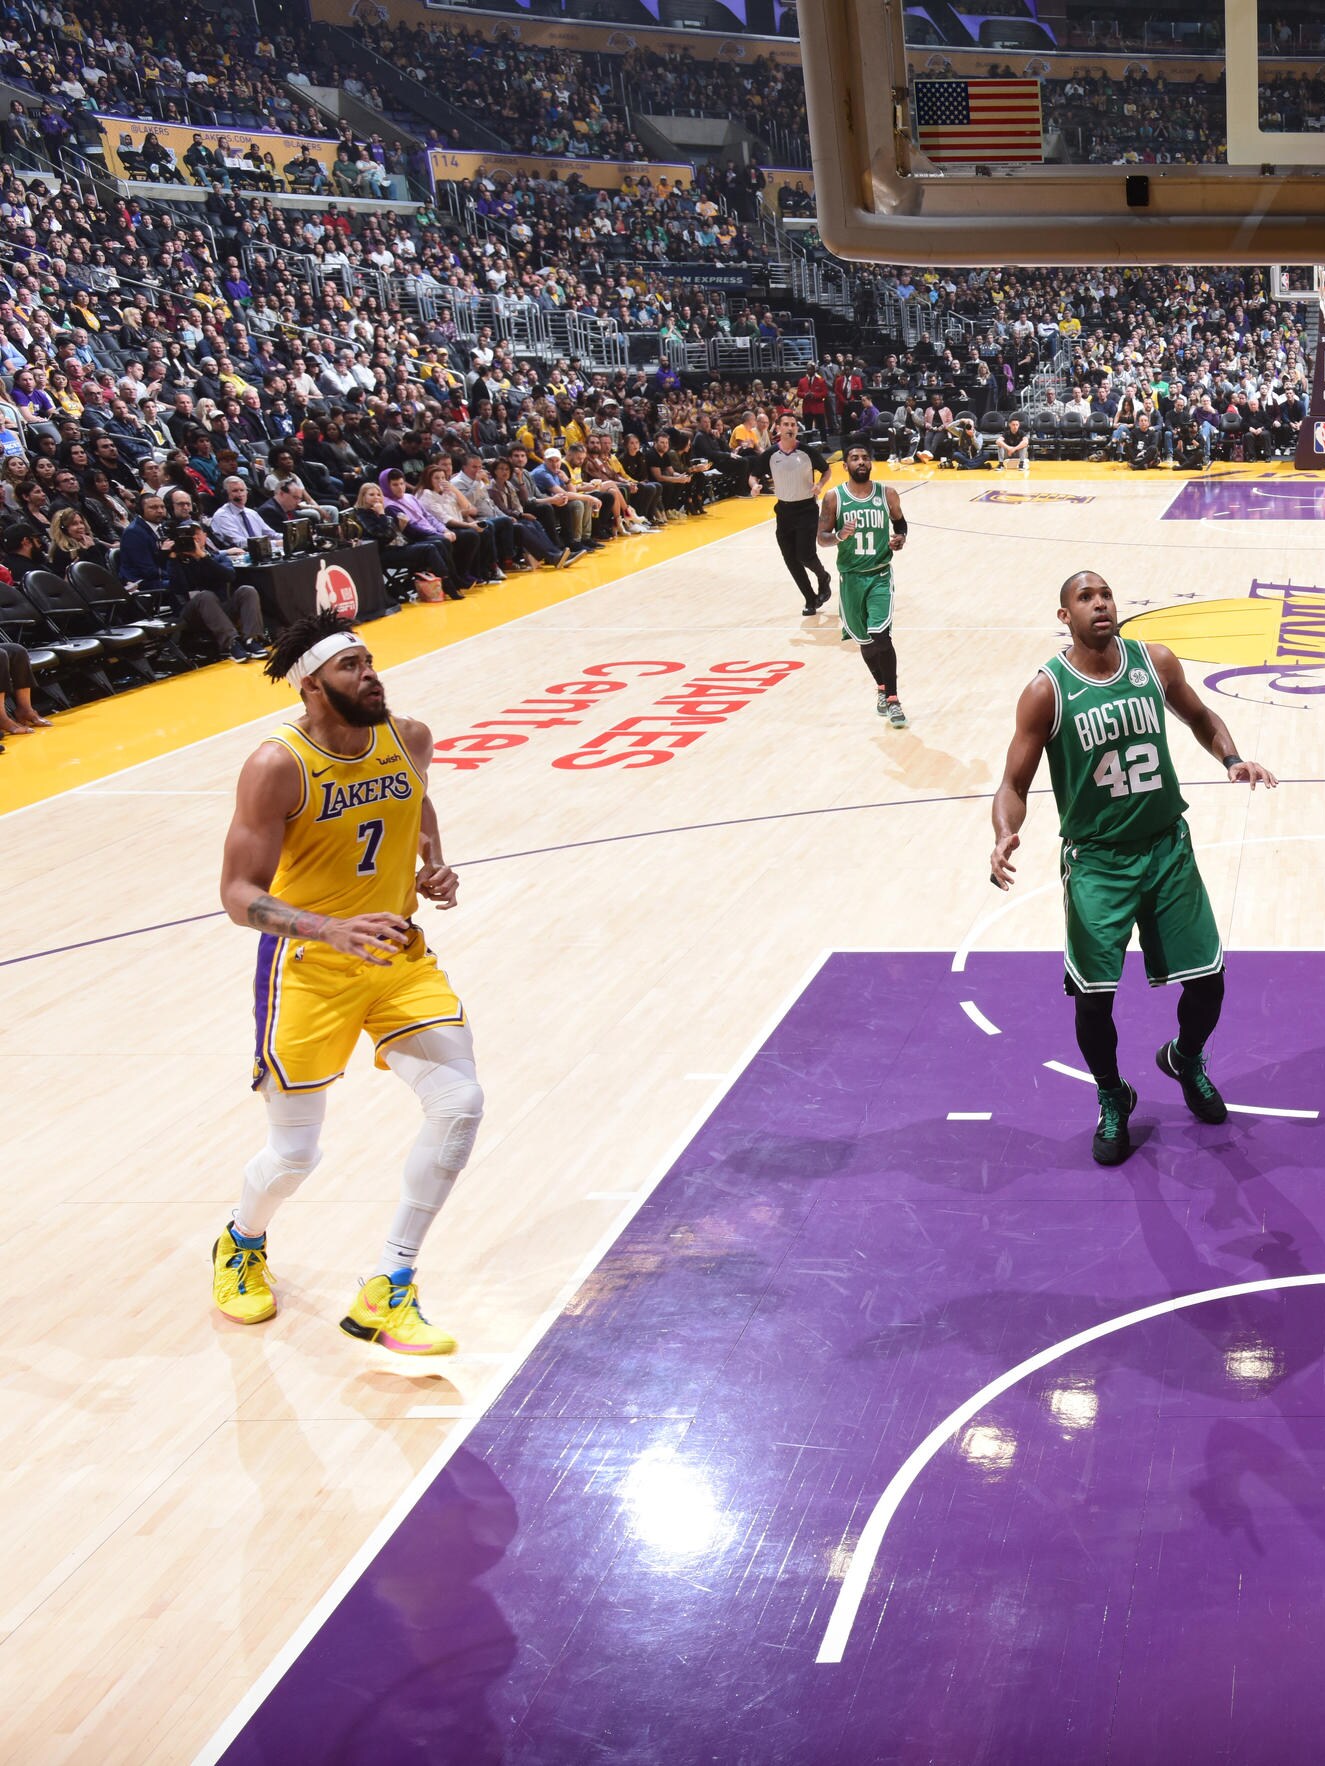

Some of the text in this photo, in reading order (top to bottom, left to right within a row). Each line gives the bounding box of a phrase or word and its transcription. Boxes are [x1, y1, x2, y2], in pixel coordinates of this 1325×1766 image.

[432, 153, 459, 168] 114
[695, 276, 743, 284] EXPRESS
[854, 532, 877, 555] 11
[432, 660, 686, 770] Center
[551, 660, 805, 770] STAPLES
[1074, 697, 1161, 752] BOSTON
[376, 754, 401, 766] wish
[1093, 743, 1162, 798] 42
[315, 771, 412, 823] LAKERS
[356, 818, 384, 877] 7
